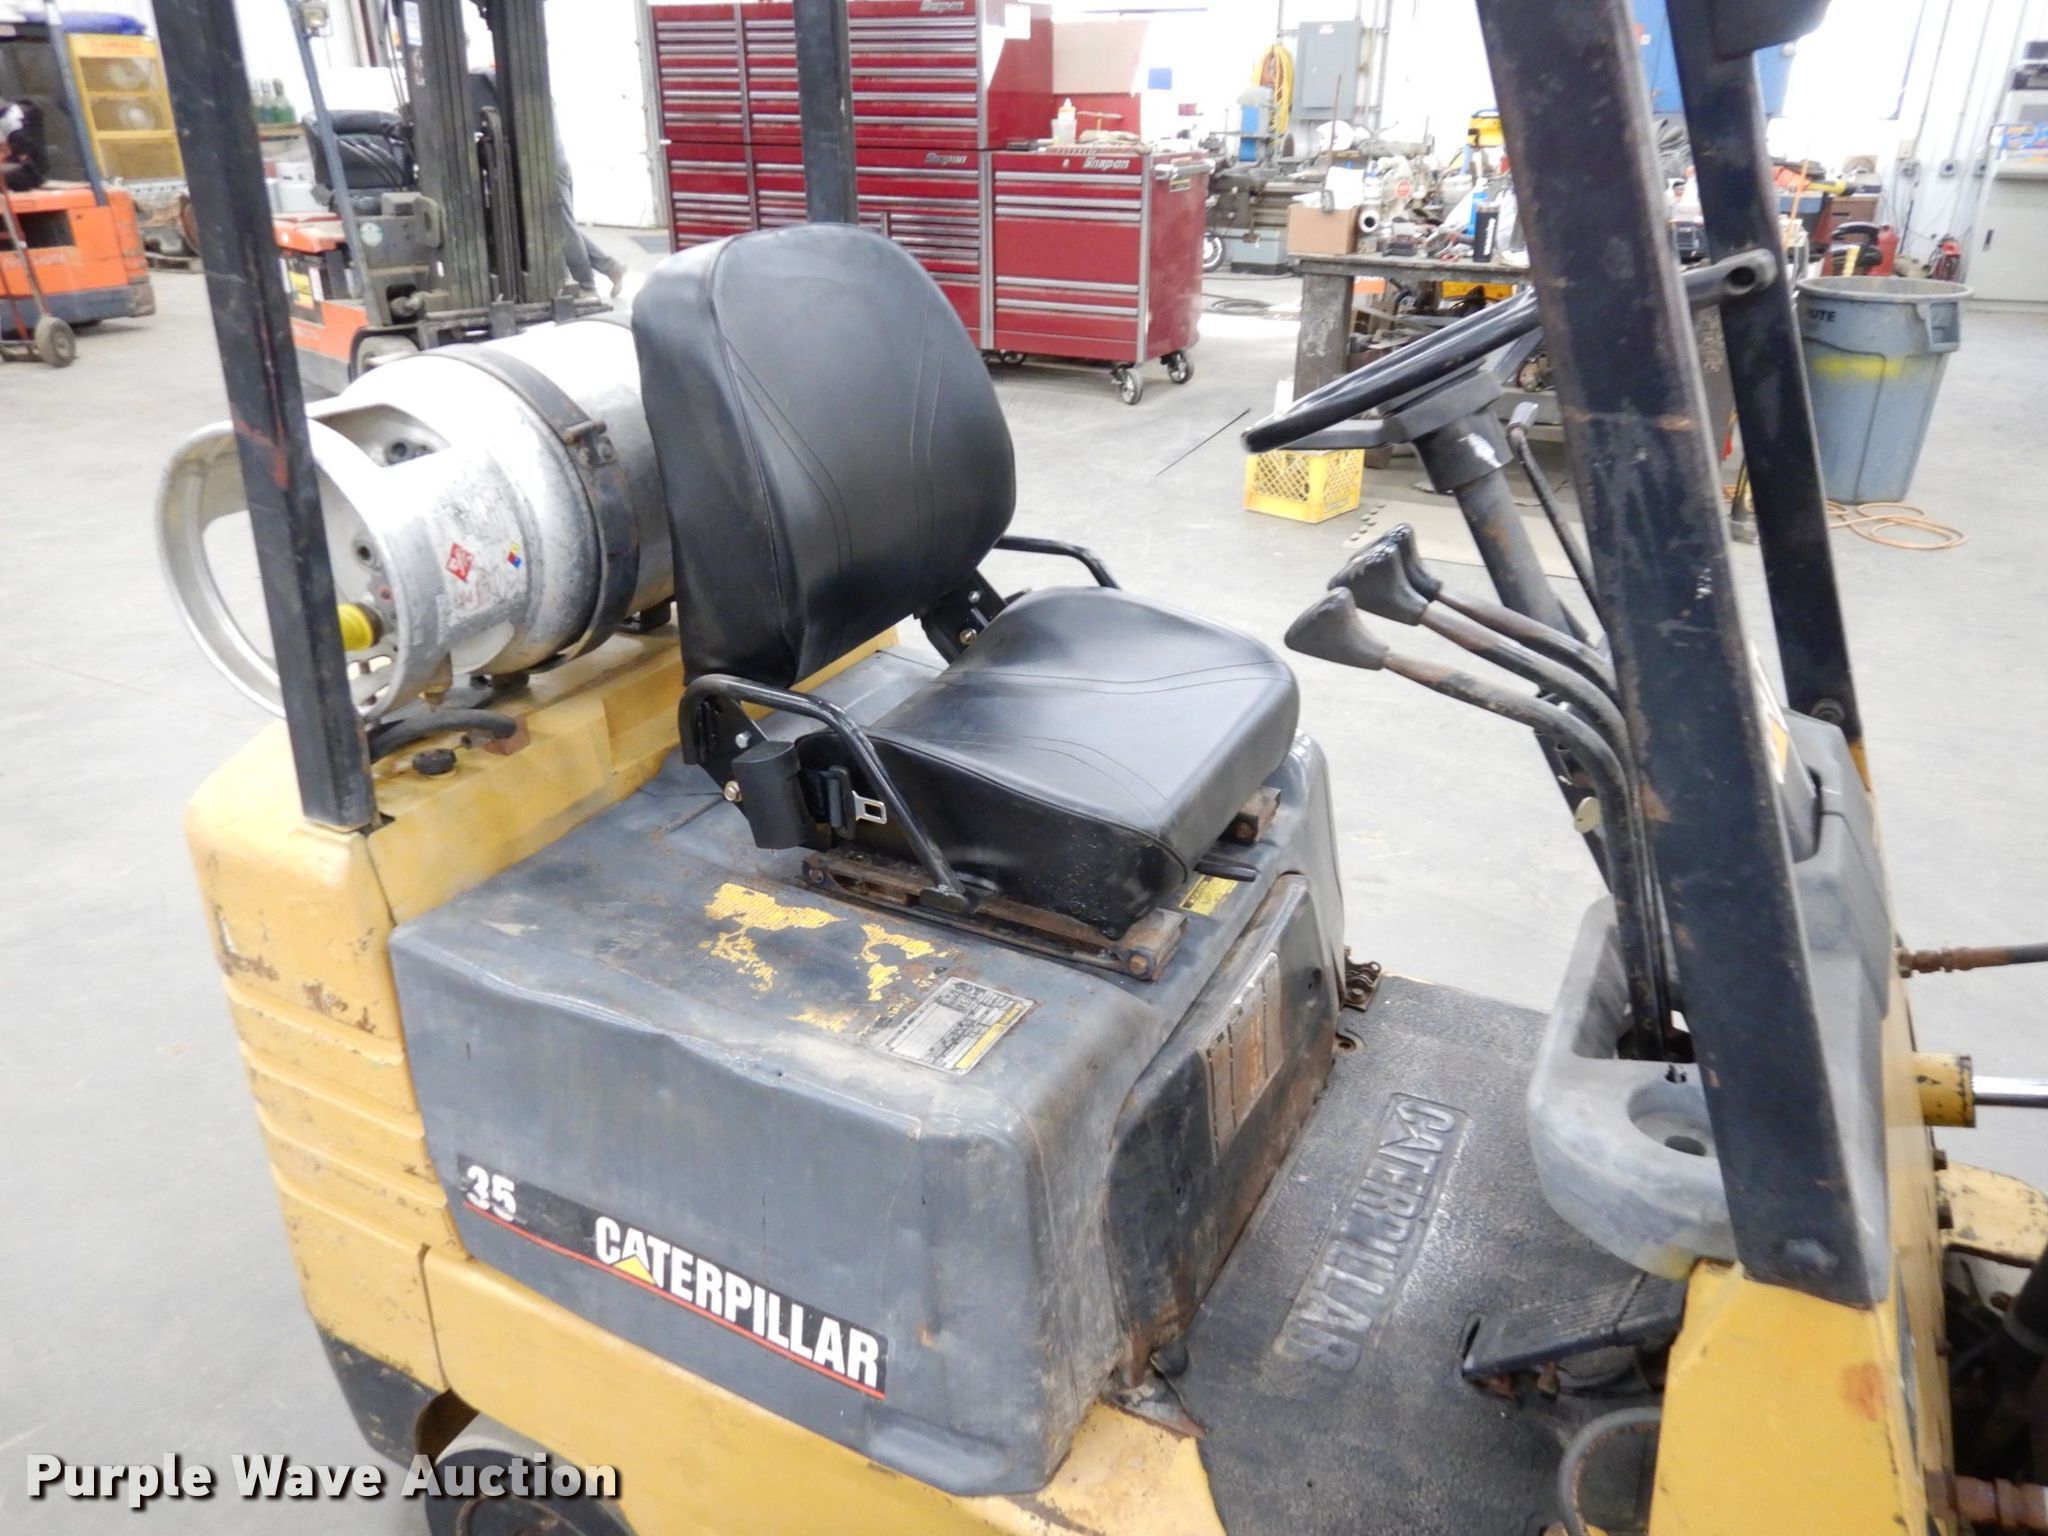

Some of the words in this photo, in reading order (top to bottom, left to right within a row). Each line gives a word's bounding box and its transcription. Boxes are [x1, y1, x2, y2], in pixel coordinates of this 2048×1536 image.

[1808, 309, 1836, 322] UTE
[467, 1164, 516, 1222] 35
[1297, 1101, 1455, 1371] CATERPILLAR
[595, 1216, 880, 1387] CATERPILLAR
